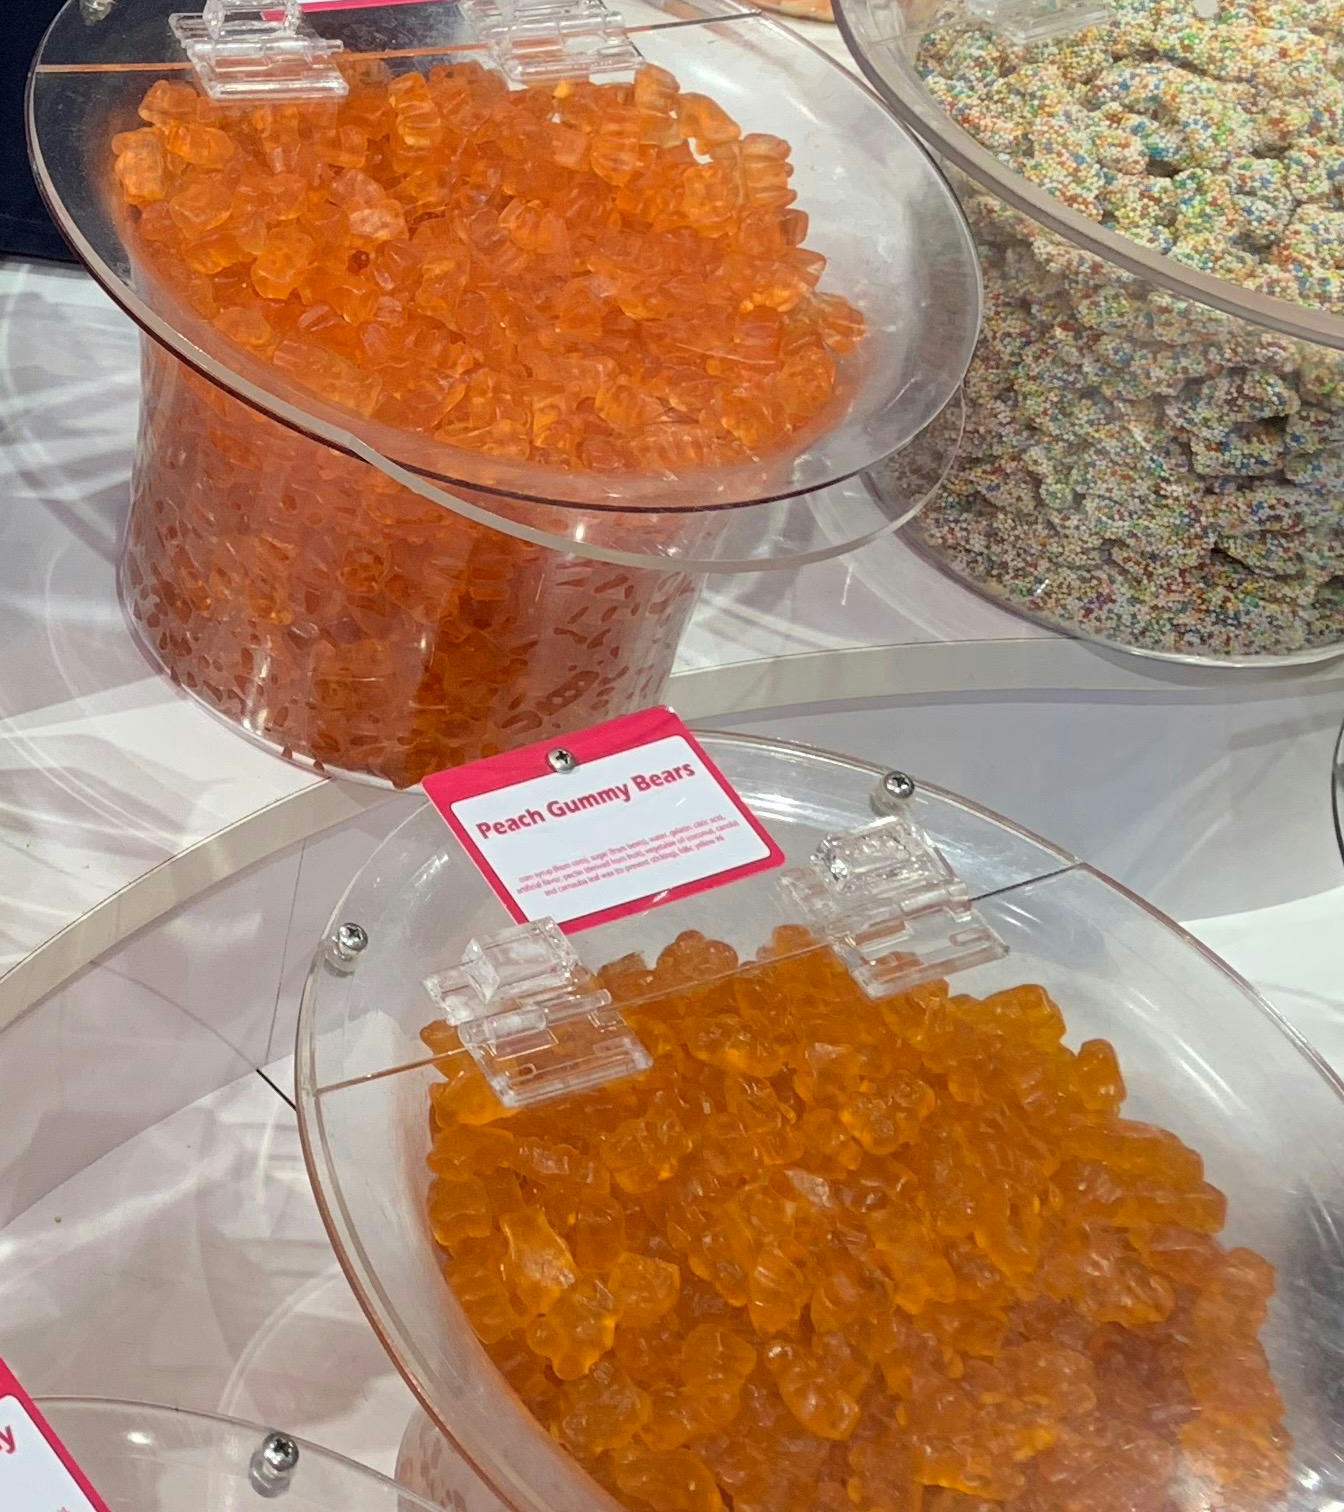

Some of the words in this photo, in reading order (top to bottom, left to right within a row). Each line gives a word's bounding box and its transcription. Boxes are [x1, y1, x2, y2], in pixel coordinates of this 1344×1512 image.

[475, 808, 546, 841] Peach
[546, 781, 632, 820] Gummy
[632, 761, 696, 793] Bears
